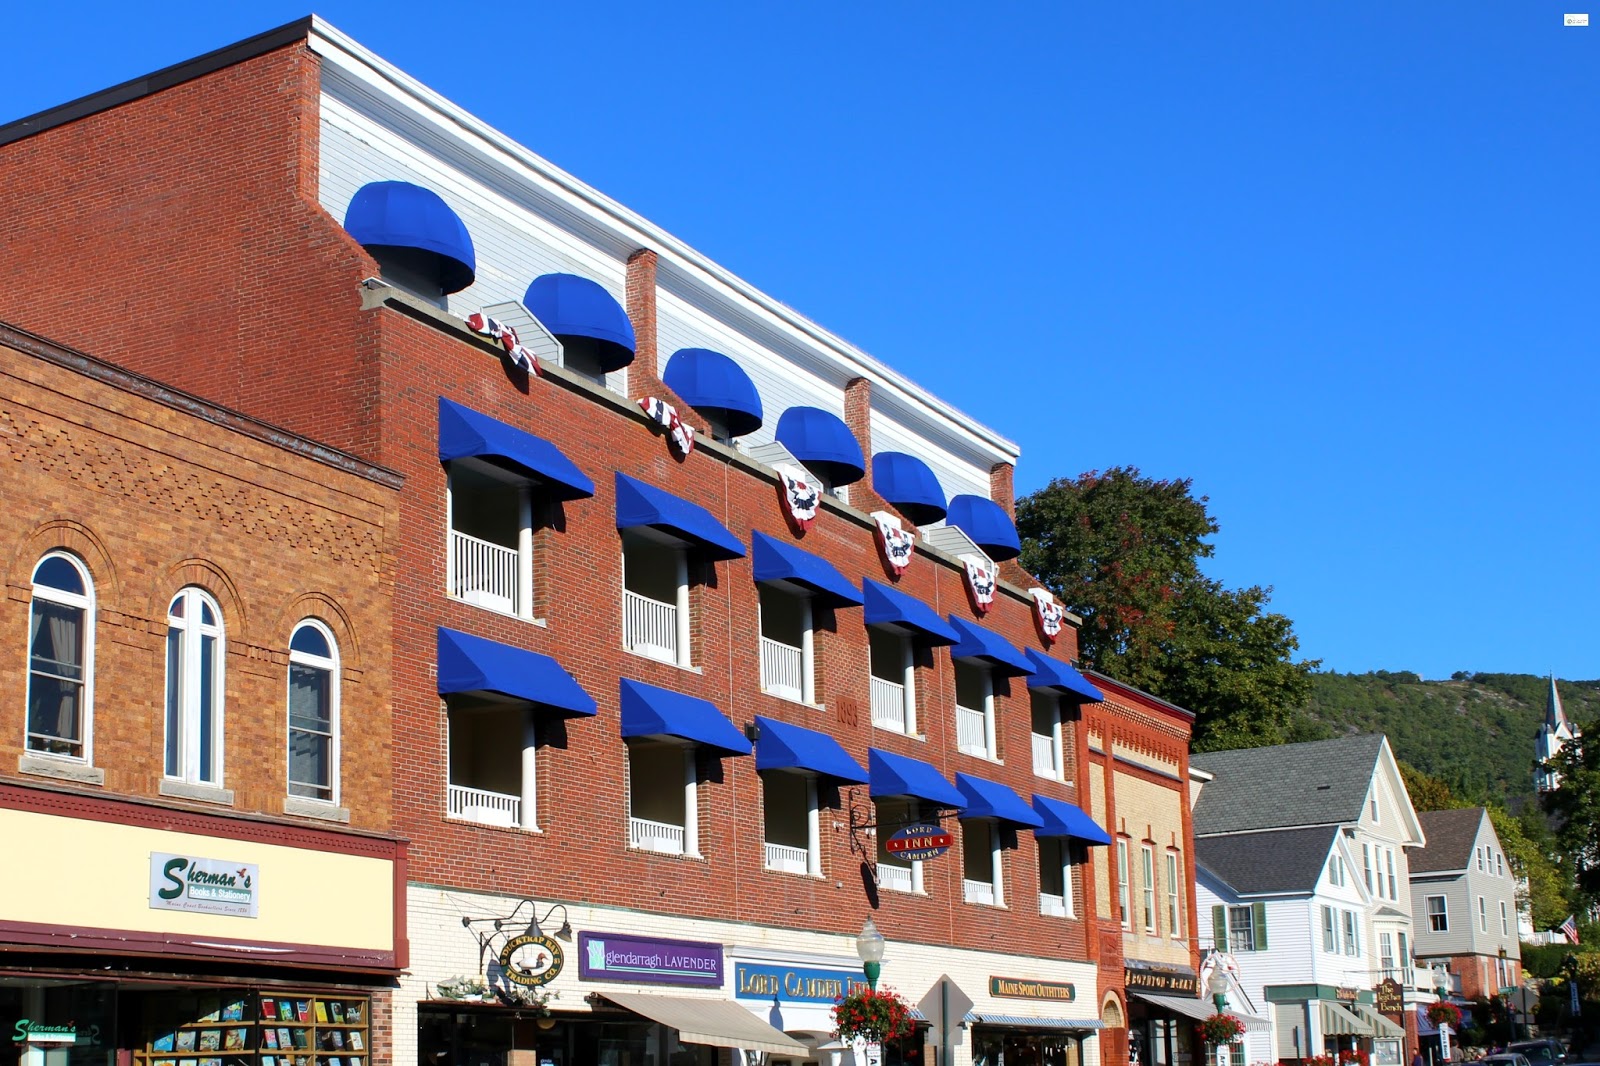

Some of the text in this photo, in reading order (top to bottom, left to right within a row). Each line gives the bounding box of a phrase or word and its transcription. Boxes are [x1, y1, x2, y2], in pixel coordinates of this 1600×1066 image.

[905, 826, 933, 835] LORD
[904, 836, 933, 849] INN
[900, 848, 939, 860] CAMDEN
[189, 886, 251, 902] Books & Stationery
[502, 936, 560, 957] DUCKTRAP BAY
[605, 950, 717, 970] glendarragh LAVENDER
[505, 969, 542, 985] TRADING
[739, 968, 779, 995] LORD
[785, 972, 842, 998] CAMDEN
[998, 980, 1070, 999] MAINE SPORT OUTFITTERS
[1380, 982, 1394, 994] The
